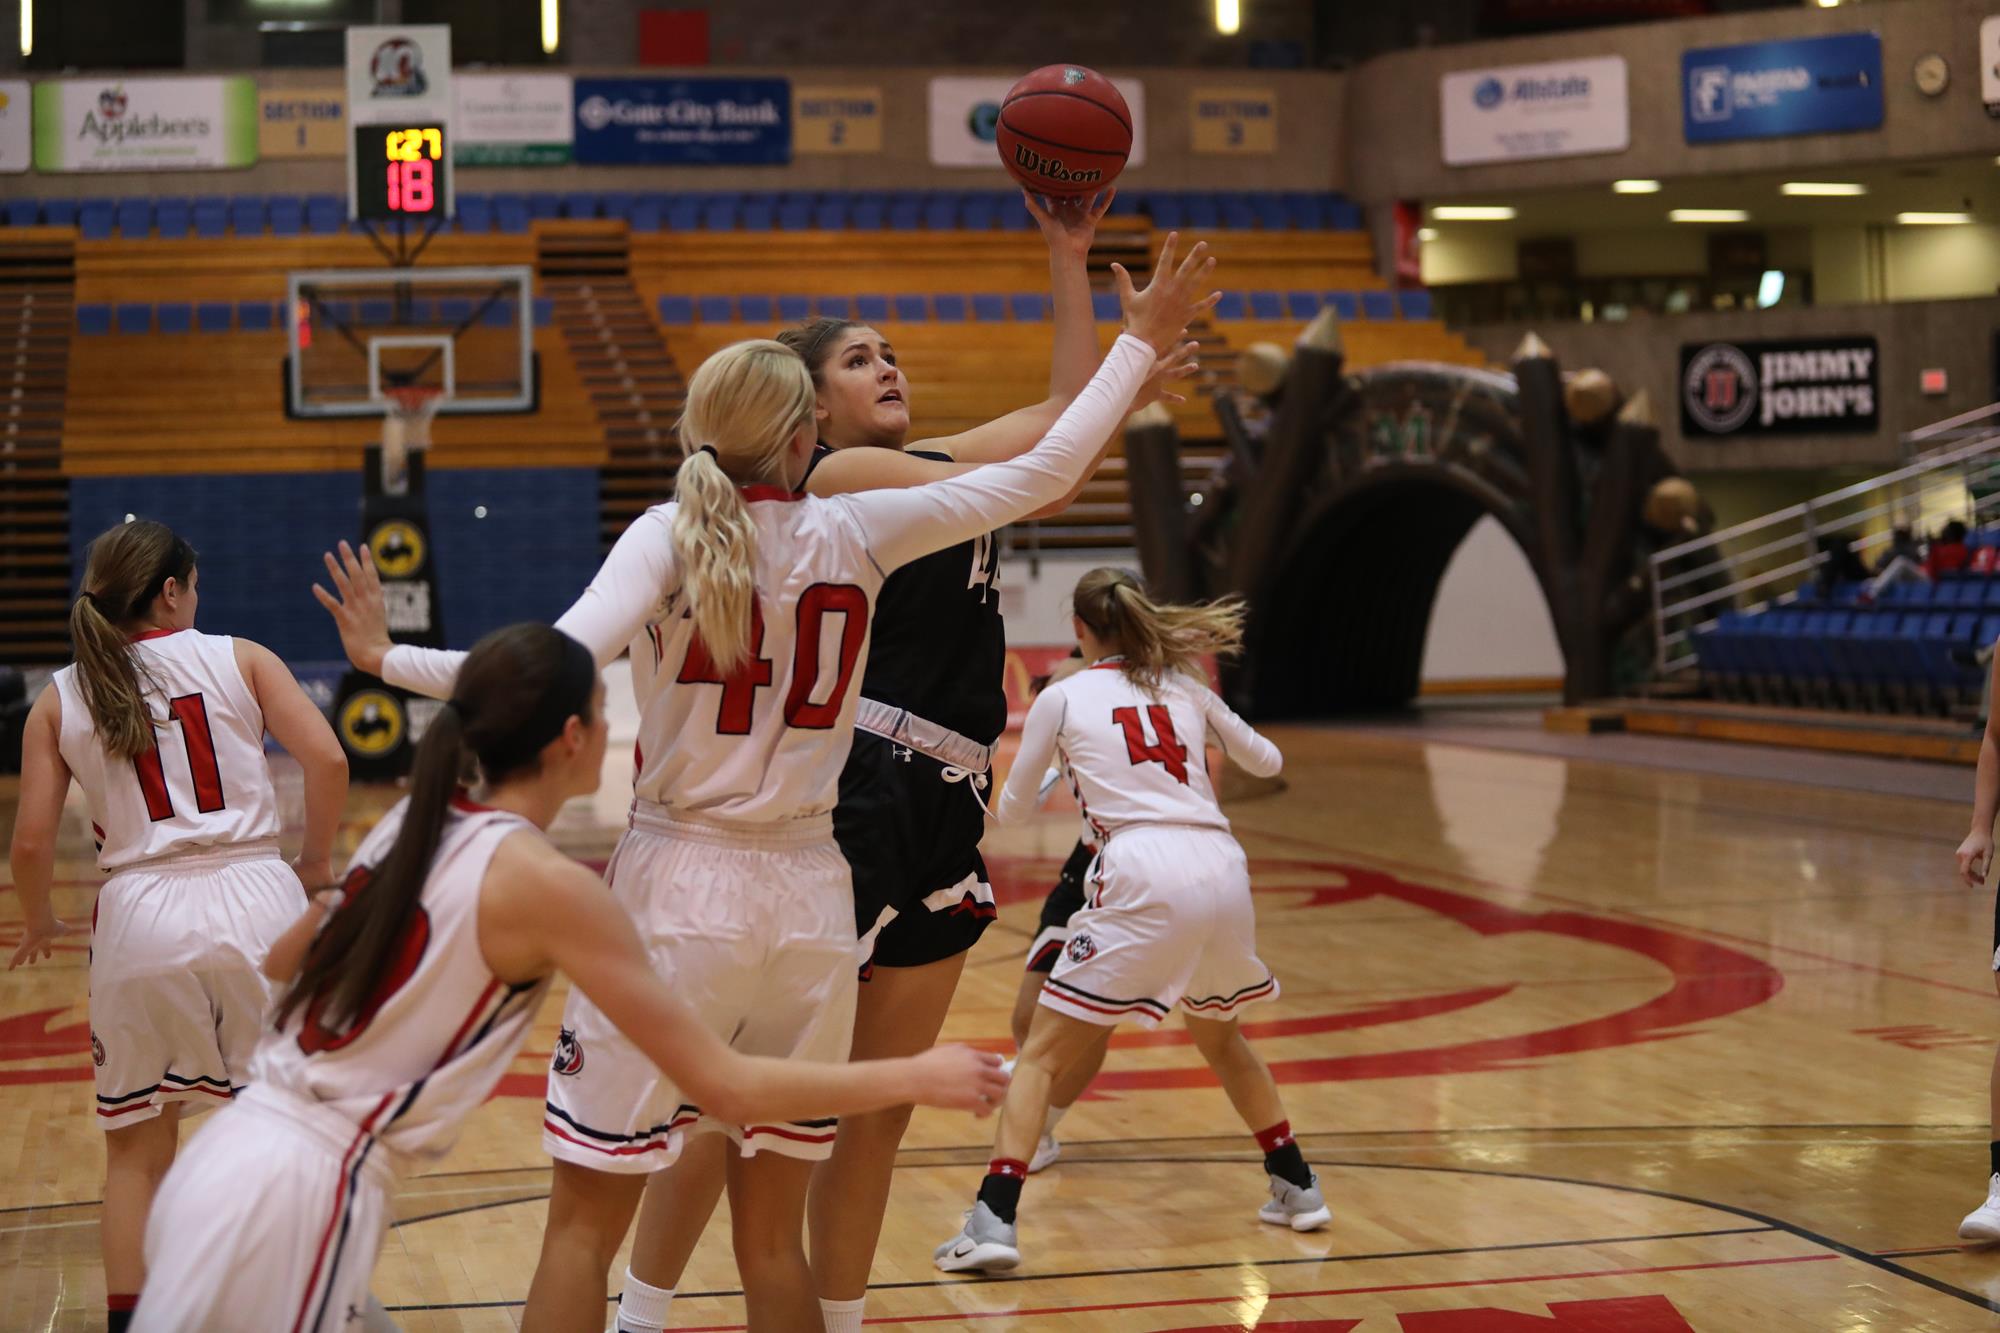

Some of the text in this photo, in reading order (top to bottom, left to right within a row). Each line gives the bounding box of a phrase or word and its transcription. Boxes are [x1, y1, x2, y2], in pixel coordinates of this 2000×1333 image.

[387, 158, 434, 213] 18
[1015, 143, 1102, 183] Wilson
[1760, 348, 1874, 386] JIMMY
[1760, 384, 1874, 427] JOHN'S
[675, 582, 868, 735] 40
[132, 692, 226, 822] 11
[1112, 704, 1189, 786] 4
